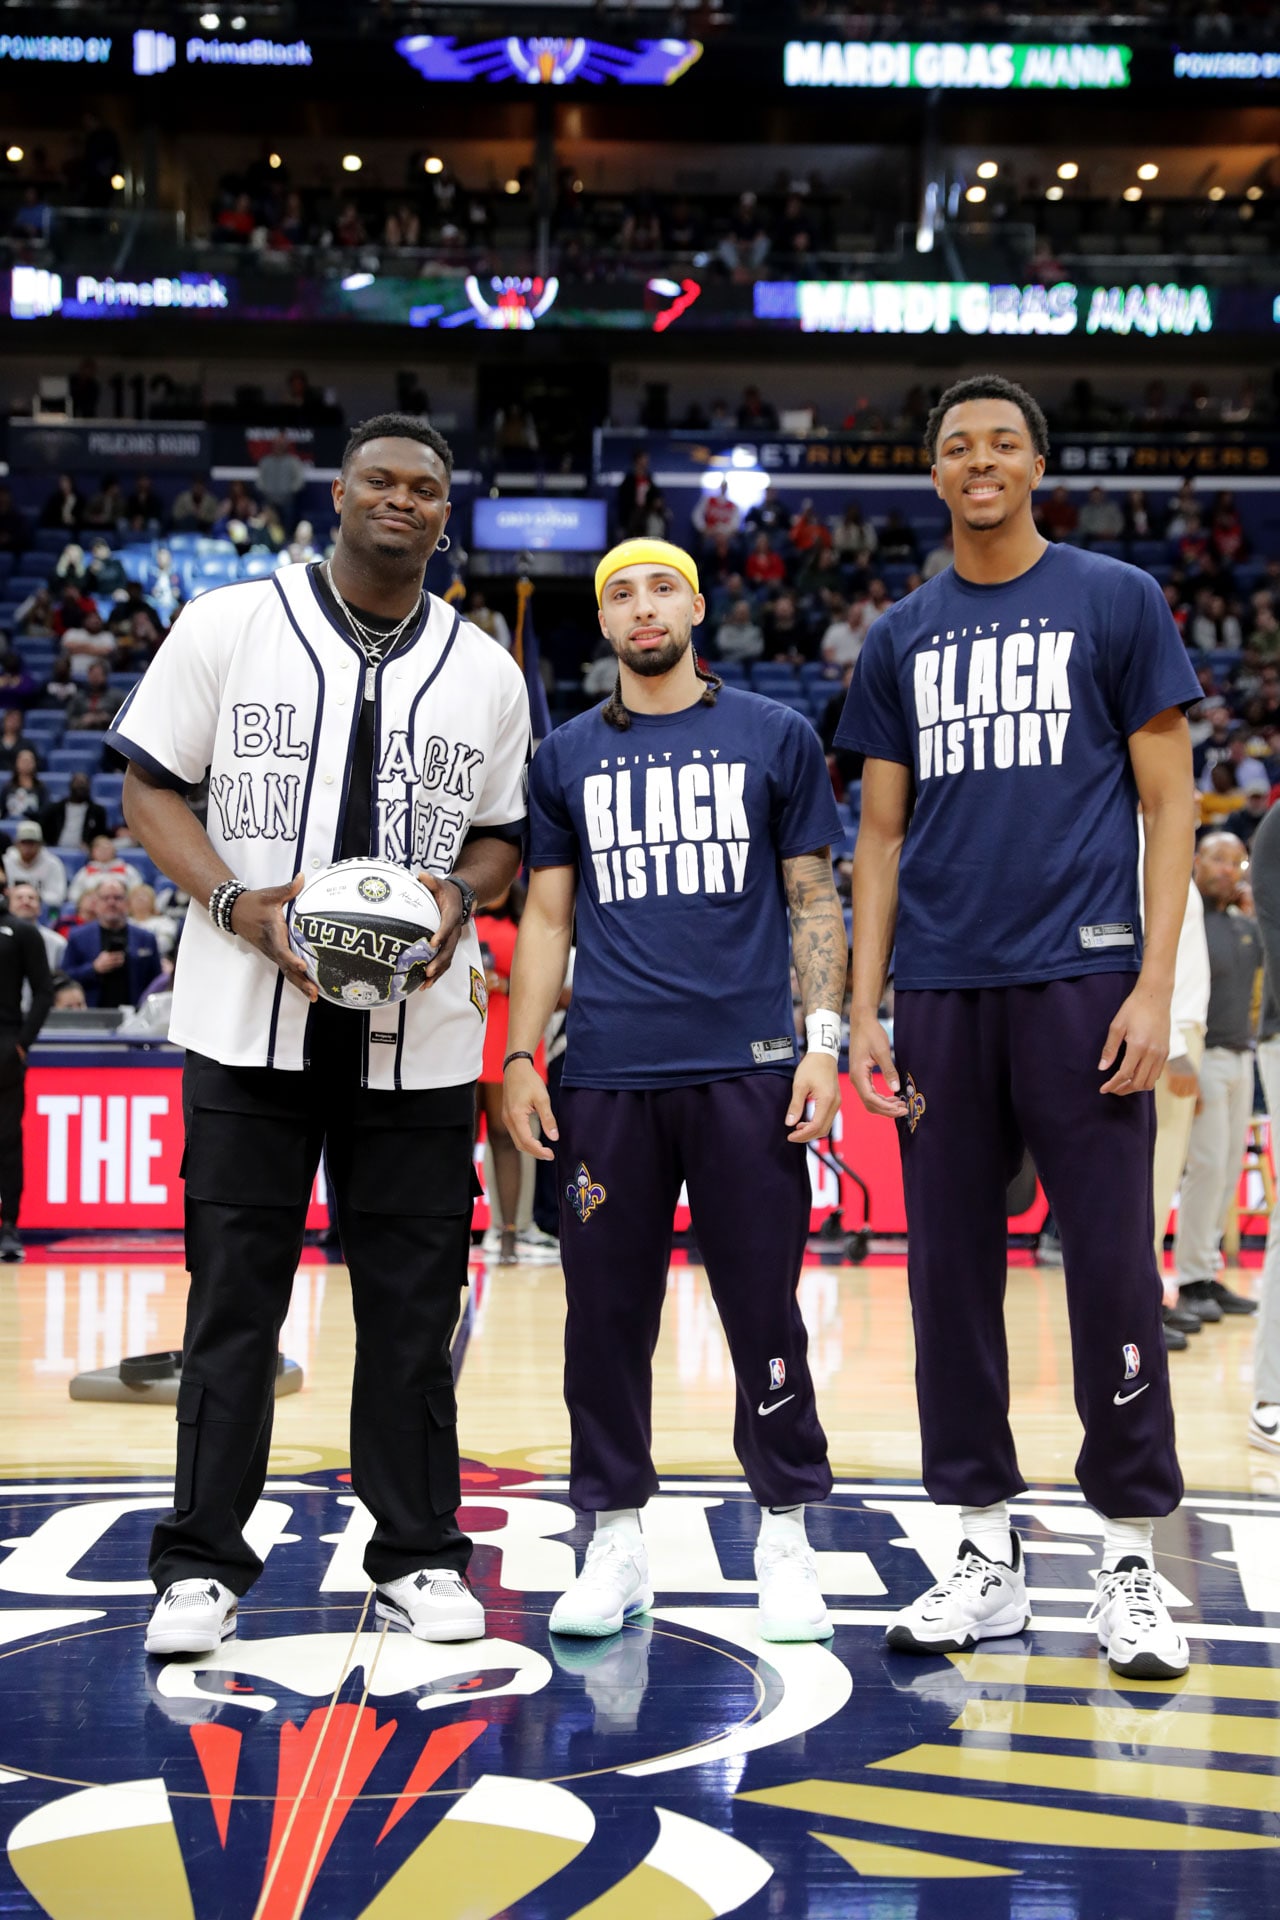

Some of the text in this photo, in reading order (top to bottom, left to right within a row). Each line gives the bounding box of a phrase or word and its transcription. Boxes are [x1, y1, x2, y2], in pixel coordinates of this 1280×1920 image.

[0, 36, 112, 63] POWERED BY
[187, 38, 312, 66] PrimeBlock
[783, 42, 1127, 90] MARDI GRAS MANIA
[1174, 52, 1262, 78] POWERED
[77, 276, 229, 308] PrimeBlock
[799, 281, 950, 333] MARDI
[958, 282, 1078, 335] GRAS
[1087, 283, 1212, 337] MANIA
[1060, 446, 1269, 470] BETRIVERS
[932, 617, 1049, 645] BUILT BY
[914, 631, 1075, 728] BLACK
[600, 749, 719, 769] BUILT BY
[919, 712, 1071, 781] HISTORY
[583, 762, 750, 852] BLACK
[591, 841, 750, 904] HISTORY
[301, 916, 413, 967] UTAH
[37, 1096, 169, 1204] THE
